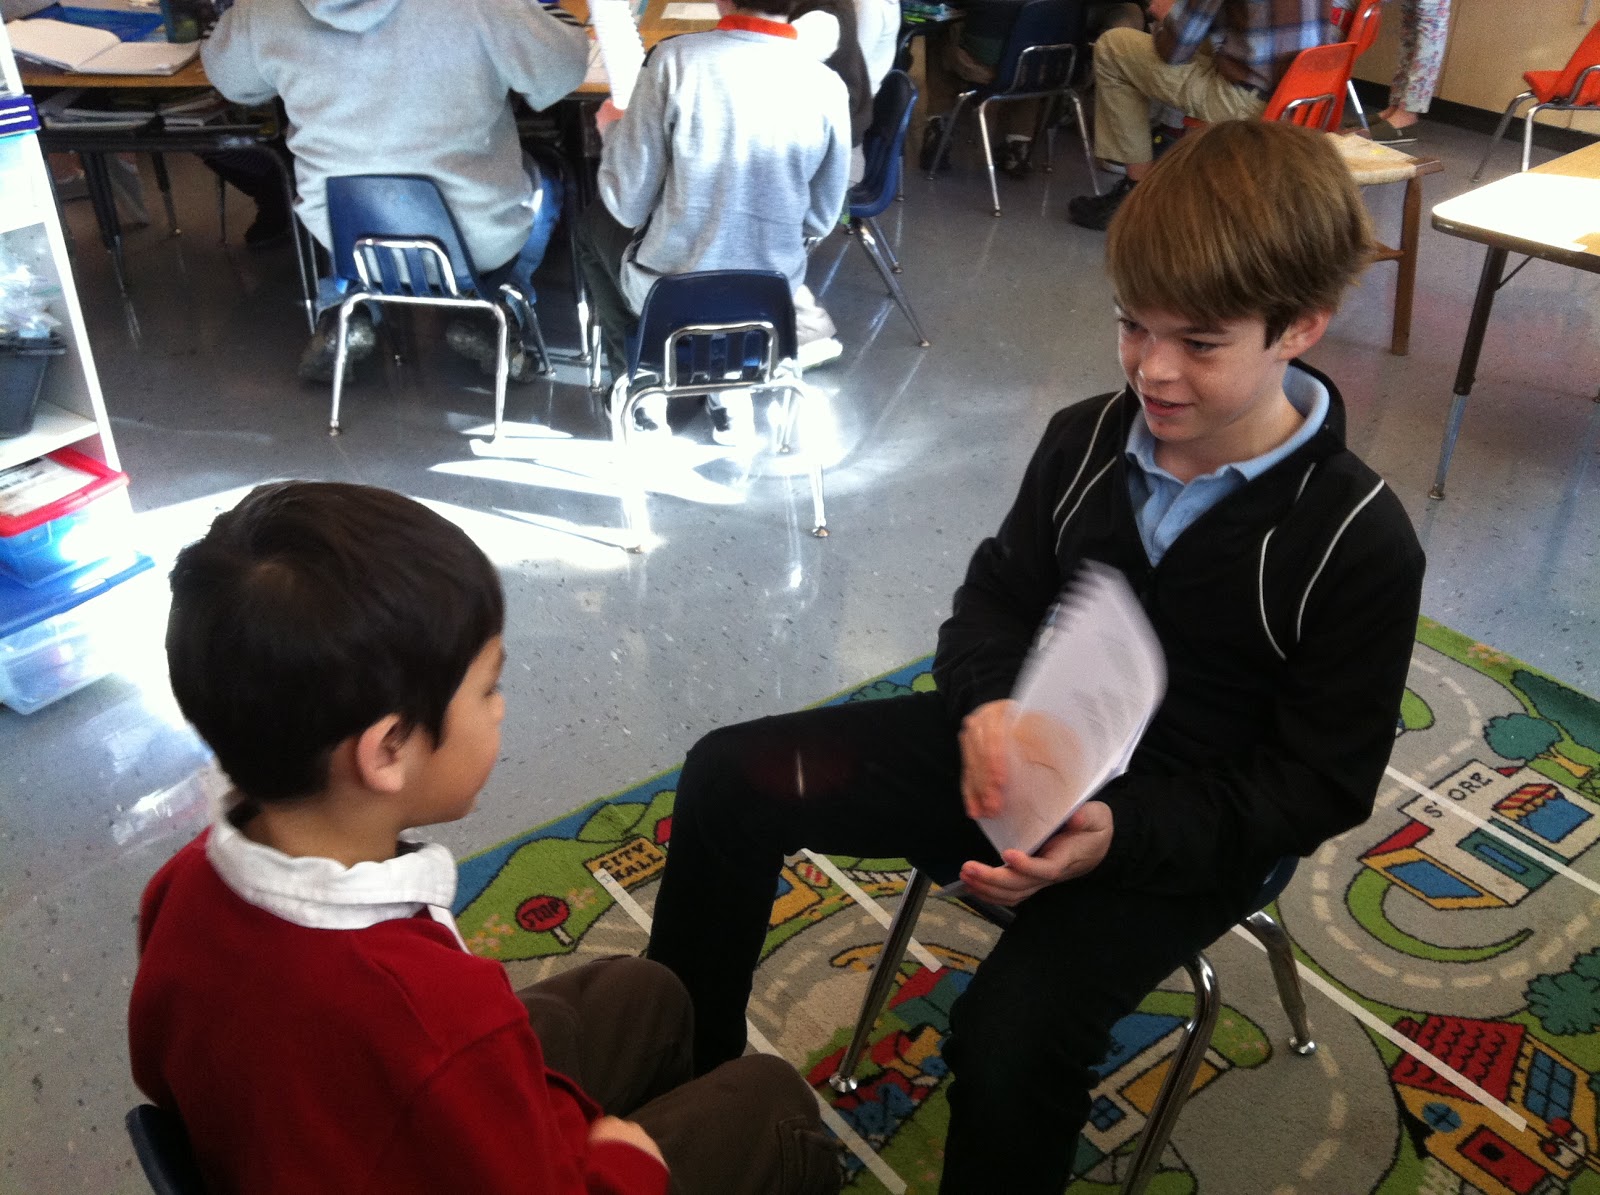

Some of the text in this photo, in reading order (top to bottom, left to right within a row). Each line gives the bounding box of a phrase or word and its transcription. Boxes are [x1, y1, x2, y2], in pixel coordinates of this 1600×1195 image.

[1423, 771, 1493, 818] SORE
[599, 842, 645, 870] CITY
[521, 899, 561, 928] STOP
